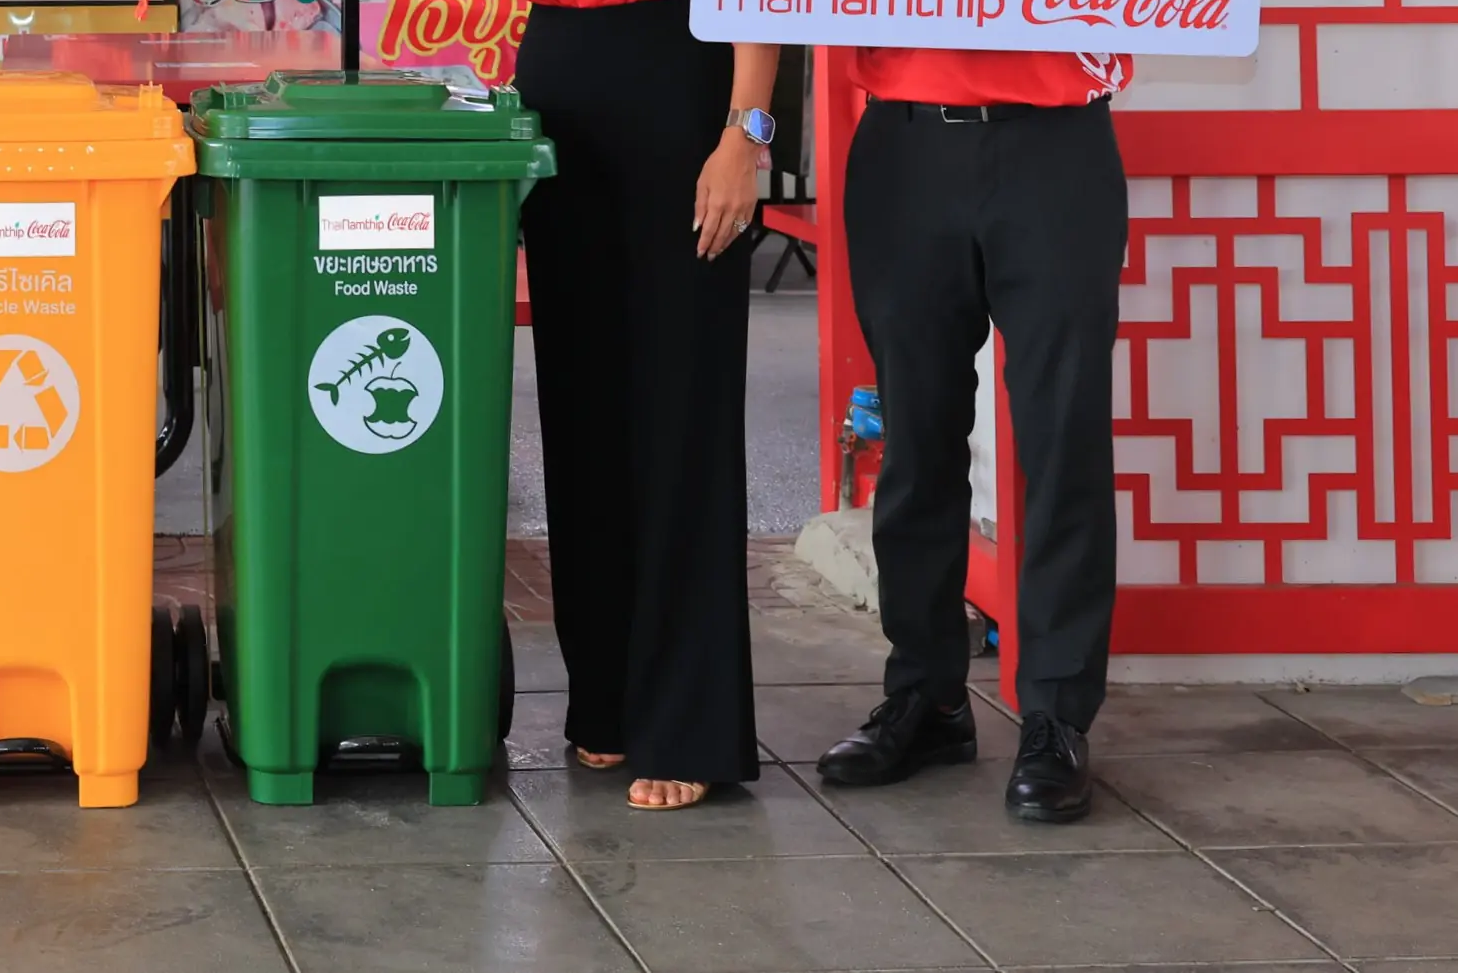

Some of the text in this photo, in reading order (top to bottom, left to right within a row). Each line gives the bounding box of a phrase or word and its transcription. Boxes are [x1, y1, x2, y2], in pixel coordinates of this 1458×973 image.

[27, 220, 72, 239] Coca-Cola
[322, 212, 431, 231] ThaiNamthip Coca-Cola
[313, 255, 438, 274] ขยะเศษอาหาร
[334, 280, 418, 296] Food Waste
[22, 299, 76, 315] Waste
